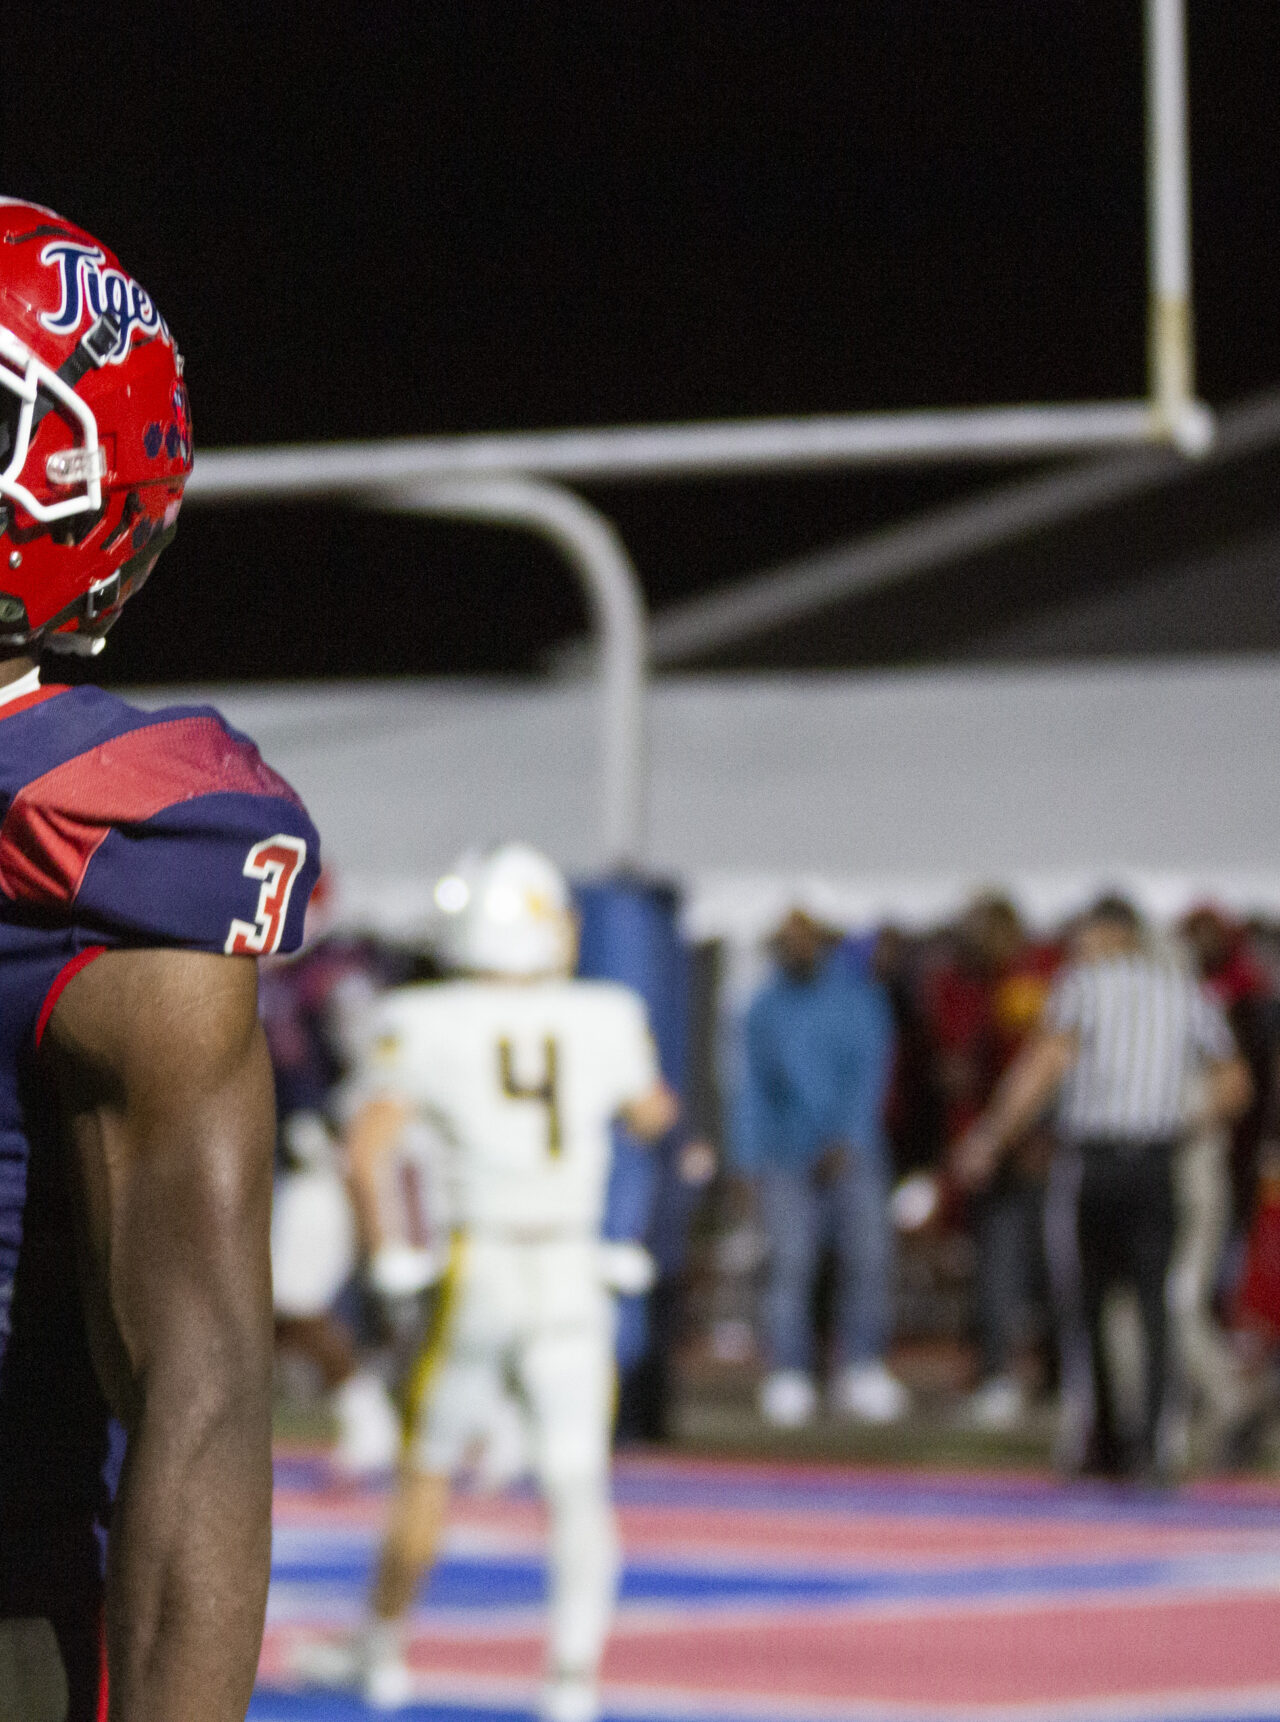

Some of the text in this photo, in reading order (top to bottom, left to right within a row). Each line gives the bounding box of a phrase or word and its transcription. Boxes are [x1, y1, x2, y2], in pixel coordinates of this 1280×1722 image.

[39, 240, 171, 365] Tige
[224, 833, 307, 956] 3
[494, 1032, 563, 1160] 4
